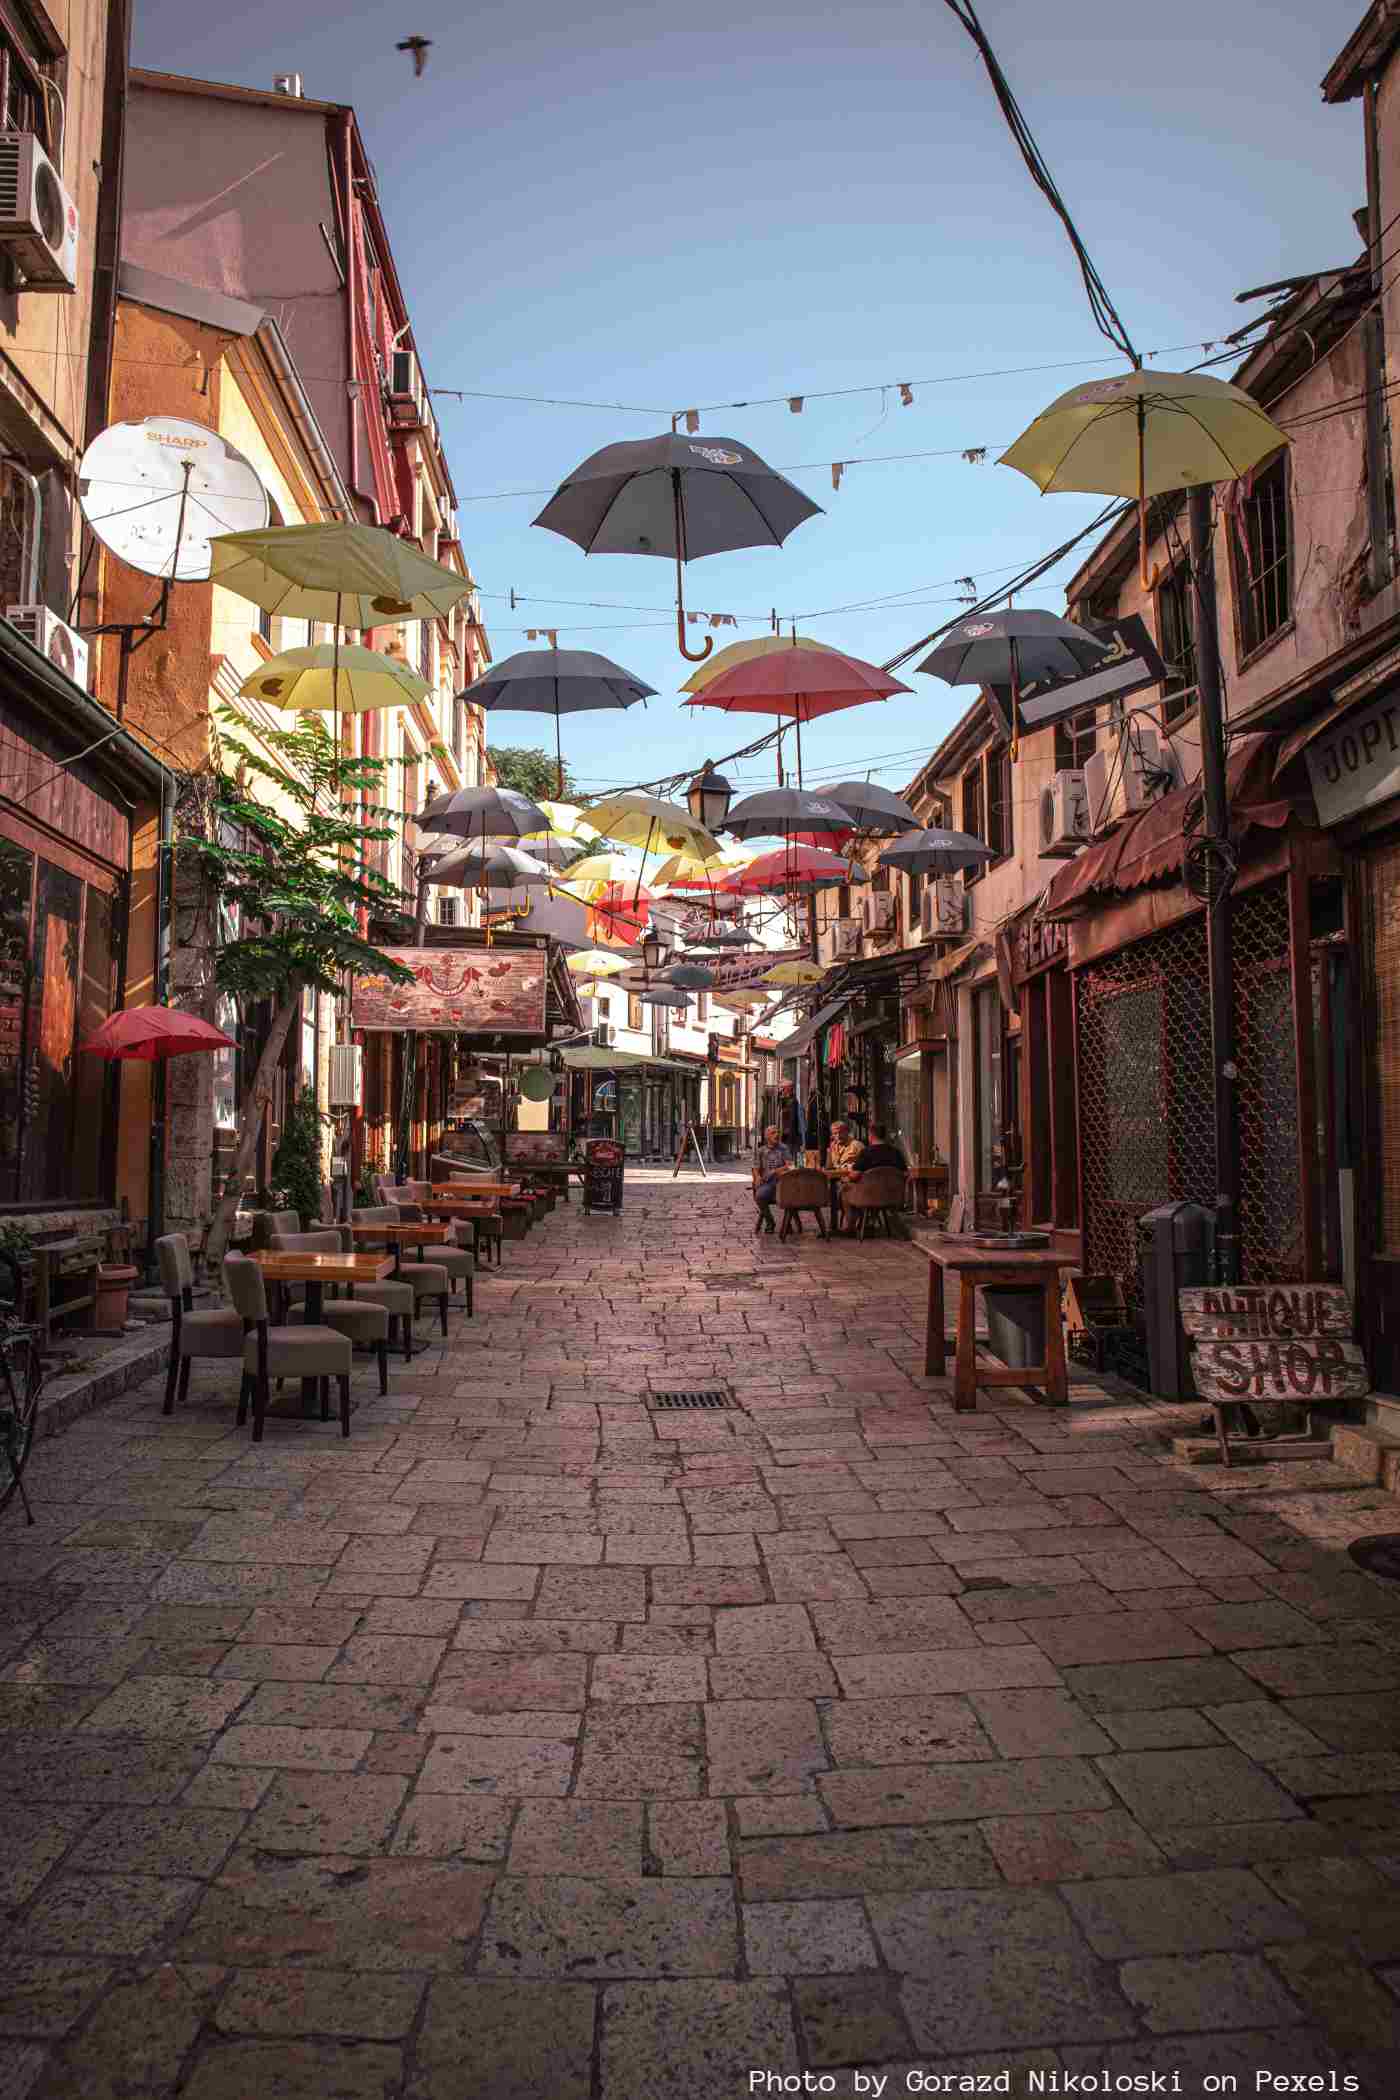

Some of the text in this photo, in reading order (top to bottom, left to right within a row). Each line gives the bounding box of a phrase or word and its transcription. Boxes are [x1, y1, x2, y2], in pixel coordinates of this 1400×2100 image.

[145, 431, 208, 449] SHARP
[1202, 1289, 1335, 1339] ANTIQUE
[1212, 1342, 1346, 1396] SHOP
